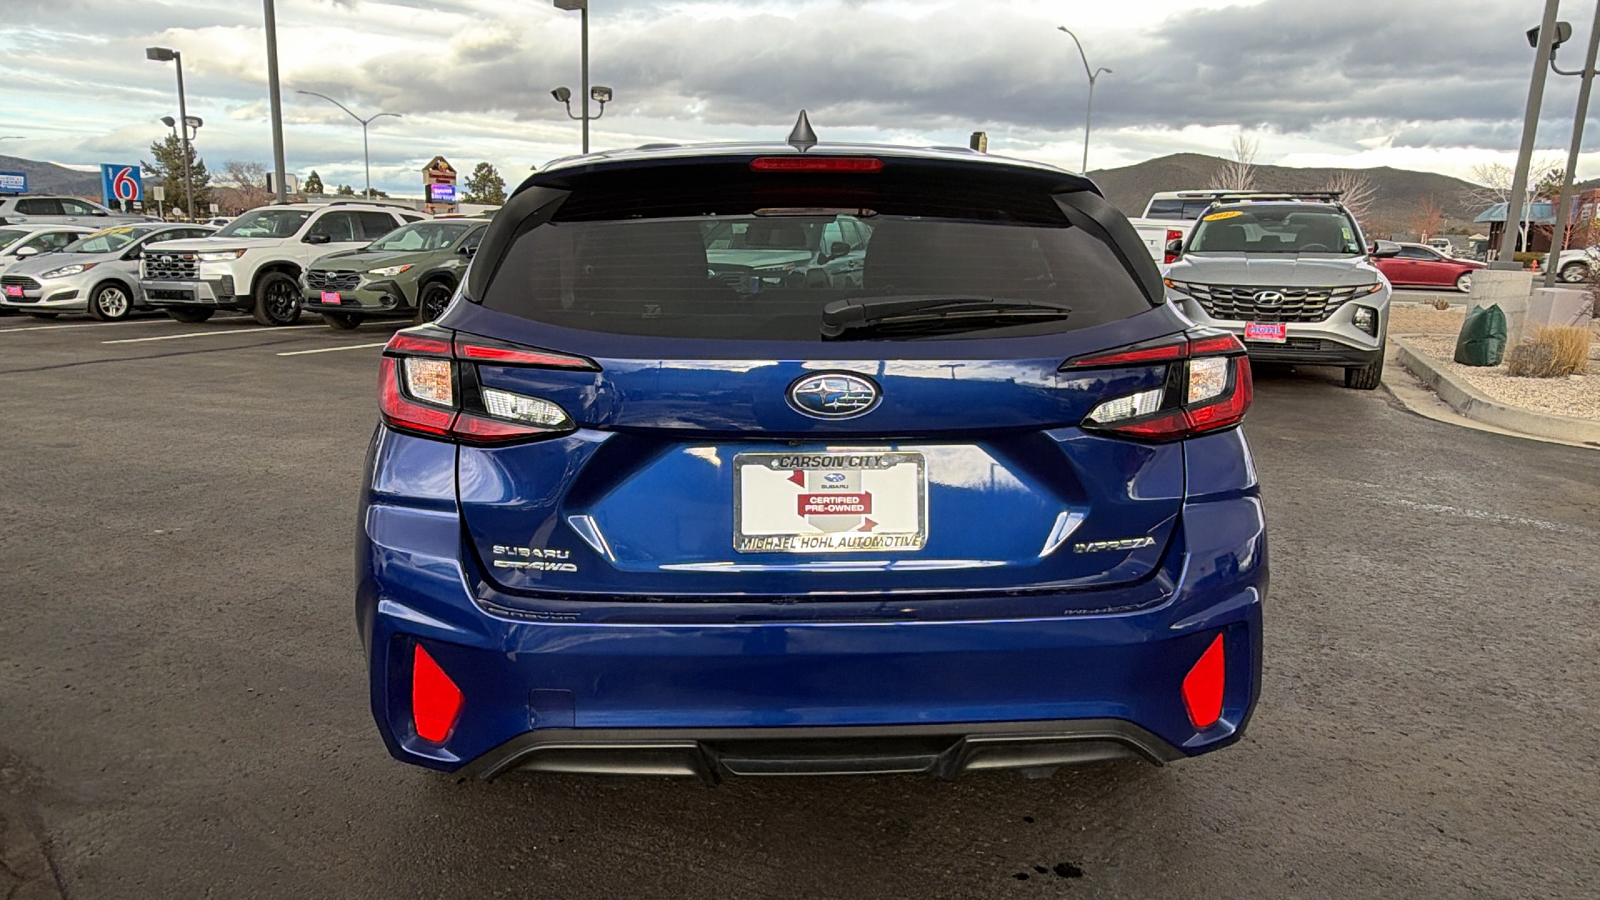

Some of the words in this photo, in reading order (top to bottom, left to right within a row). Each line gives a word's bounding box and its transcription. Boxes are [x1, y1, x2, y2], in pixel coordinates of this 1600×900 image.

[114, 166, 139, 201] 6
[779, 455, 844, 468] CARSON
[848, 455, 883, 467] CITY
[809, 496, 860, 504] CERTIFIED
[805, 504, 865, 512] PRE-OWNED
[741, 536, 796, 550] MICHAEL
[800, 536, 834, 549] HOHL
[838, 535, 921, 549] AUTOMOTIVE
[1073, 536, 1156, 553] IMPREZA
[492, 545, 570, 559] SUBARU
